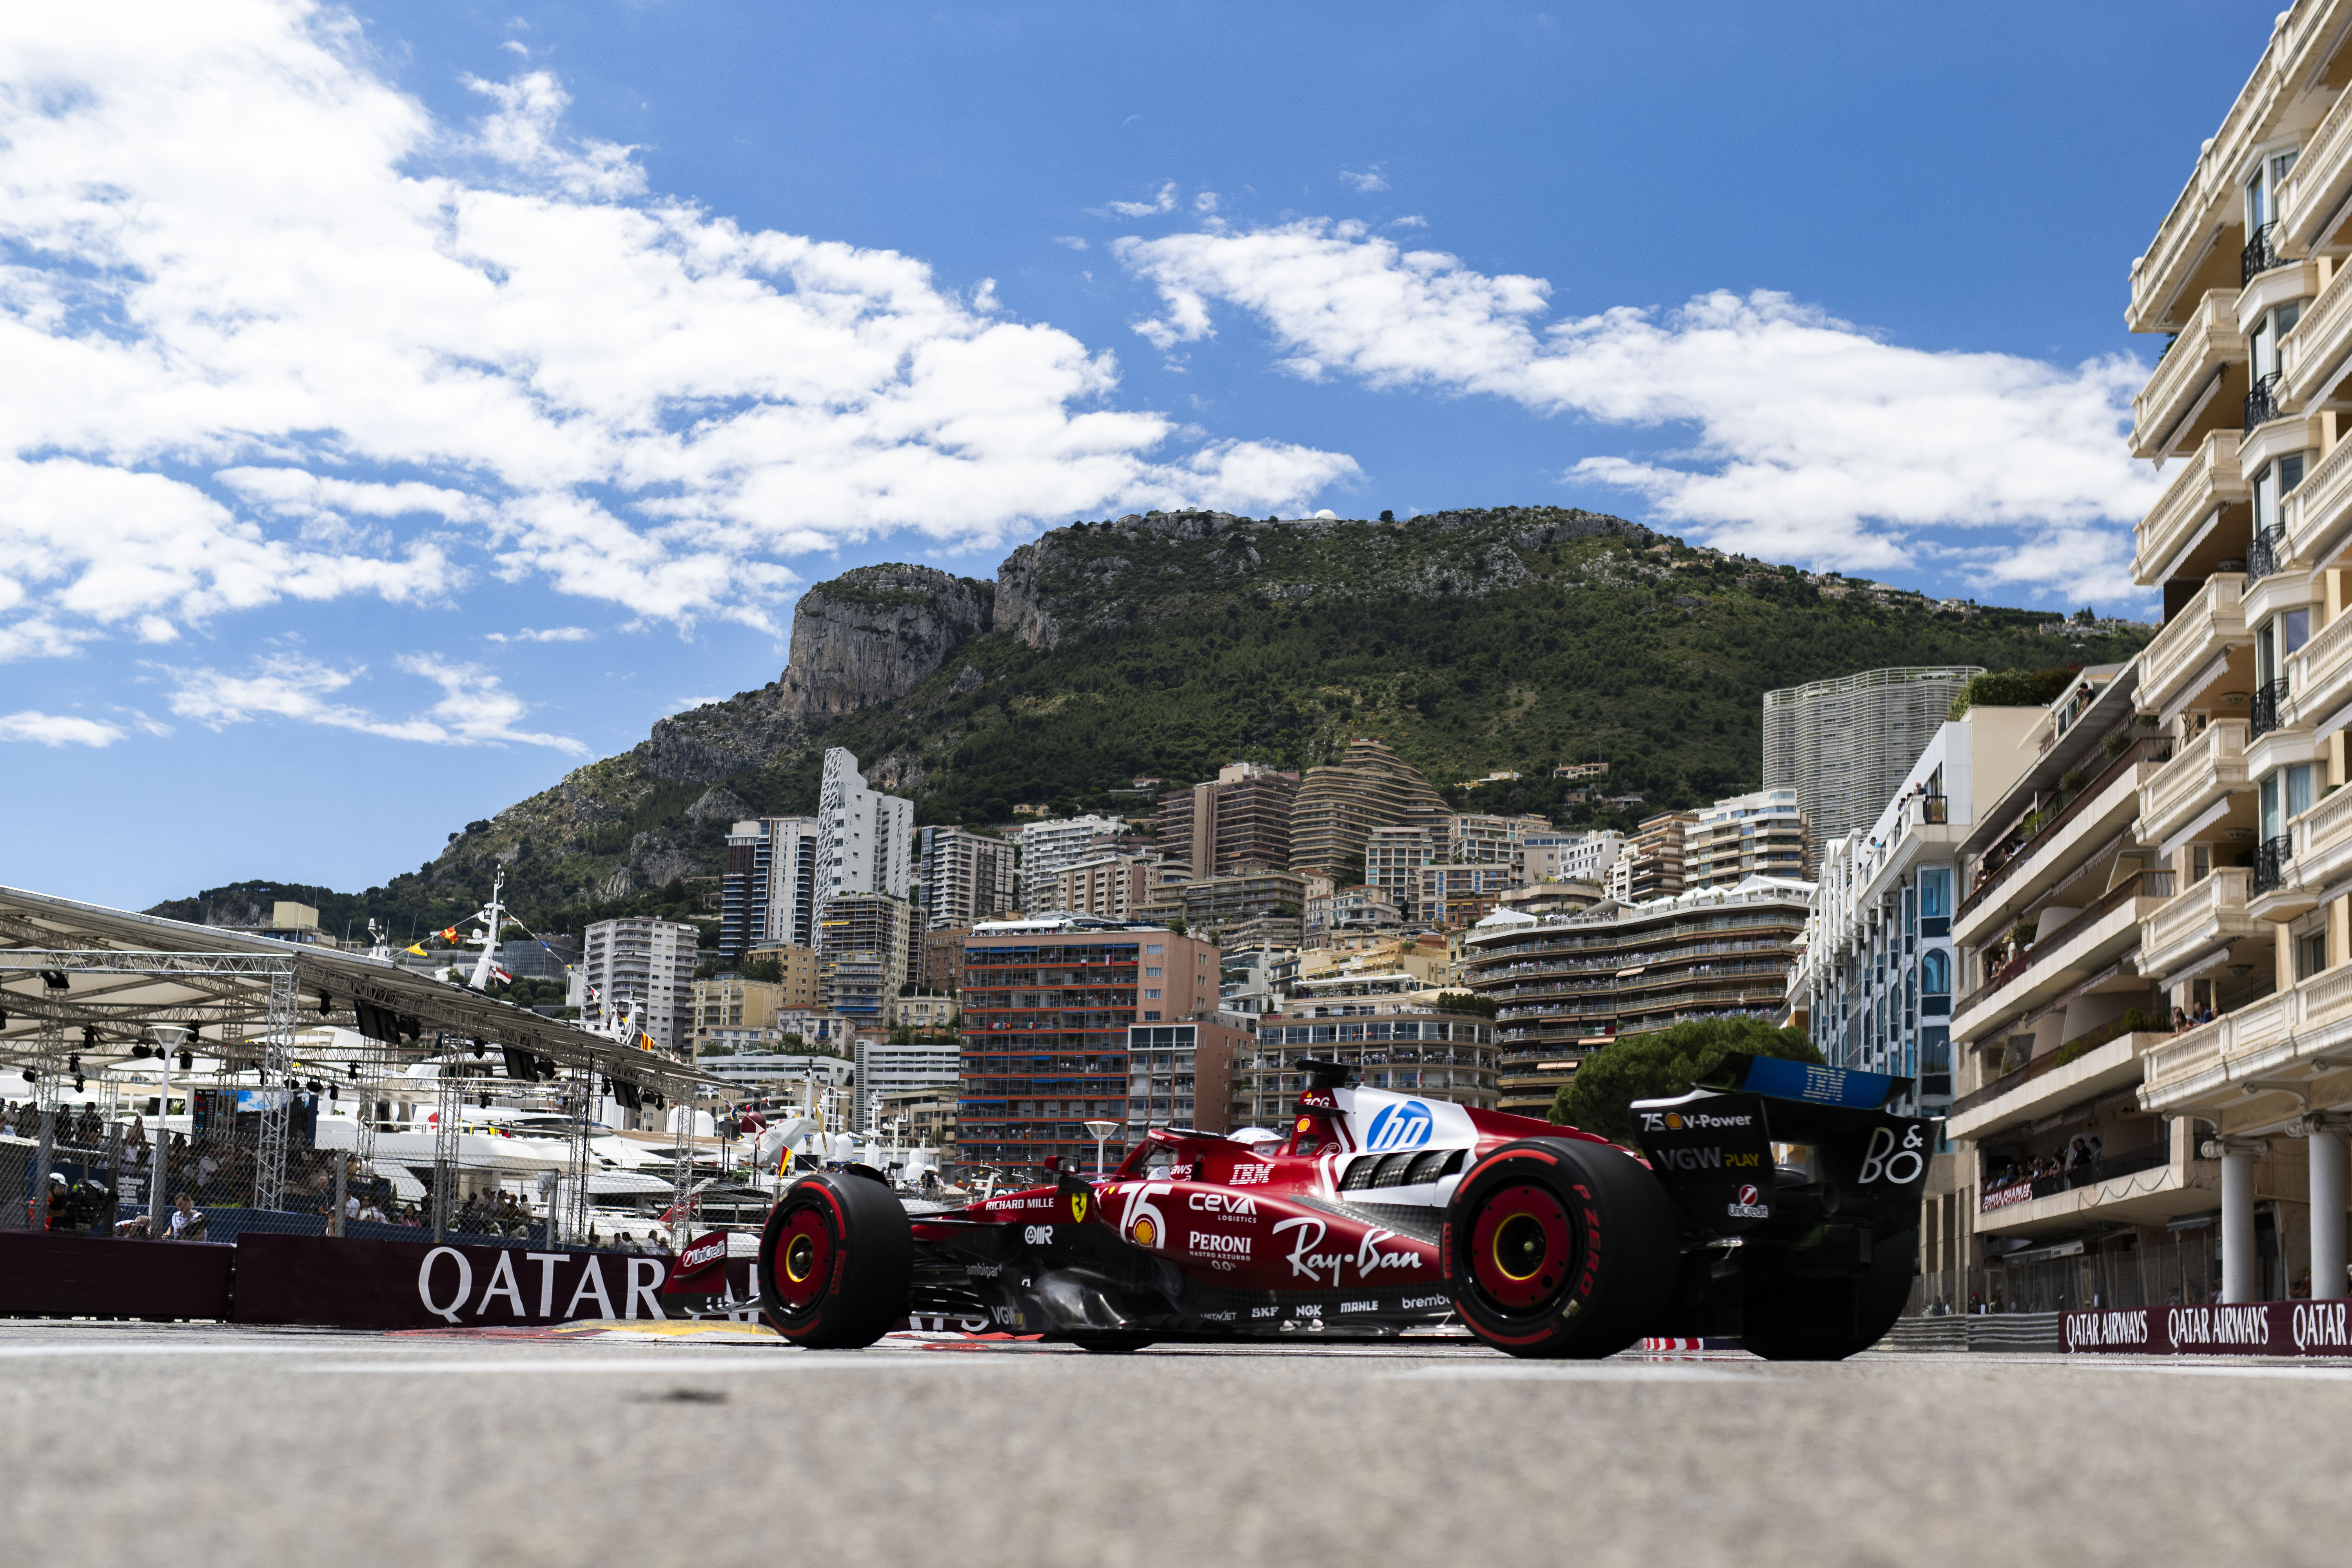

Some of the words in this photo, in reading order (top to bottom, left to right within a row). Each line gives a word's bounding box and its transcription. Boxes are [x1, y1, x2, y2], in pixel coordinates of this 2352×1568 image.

[1368, 1101, 1431, 1151] hp
[1682, 1114, 1752, 1129] V-Power
[1171, 1164, 1192, 1174] aws
[1656, 1147, 1721, 1171] VGW
[1724, 1154, 1759, 1167] PLAY
[1229, 1164, 1275, 1185] IBM
[1572, 1184, 1591, 1200] P
[985, 1199, 1024, 1210] RICHARD
[1027, 1198, 1054, 1208] MILLE
[1728, 1203, 1769, 1218] UniCredit
[1218, 1215, 1257, 1223] LOGISTICS
[1189, 1230, 1251, 1254] PERONI
[1580, 1207, 1601, 1297] ZERO
[419, 1247, 666, 1323] QATAR
[1252, 1307, 1279, 1318] SKF
[1296, 1305, 1322, 1317] NGK
[1341, 1300, 1378, 1313] MAHLE
[2066, 1314, 2099, 1352] QATAR
[2101, 1310, 2147, 1345] AIRWAYS
[2168, 1308, 2210, 1348] QATAR
[2213, 1306, 2268, 1345] AIRWAYS
[2293, 1303, 2347, 1351] QATAR
